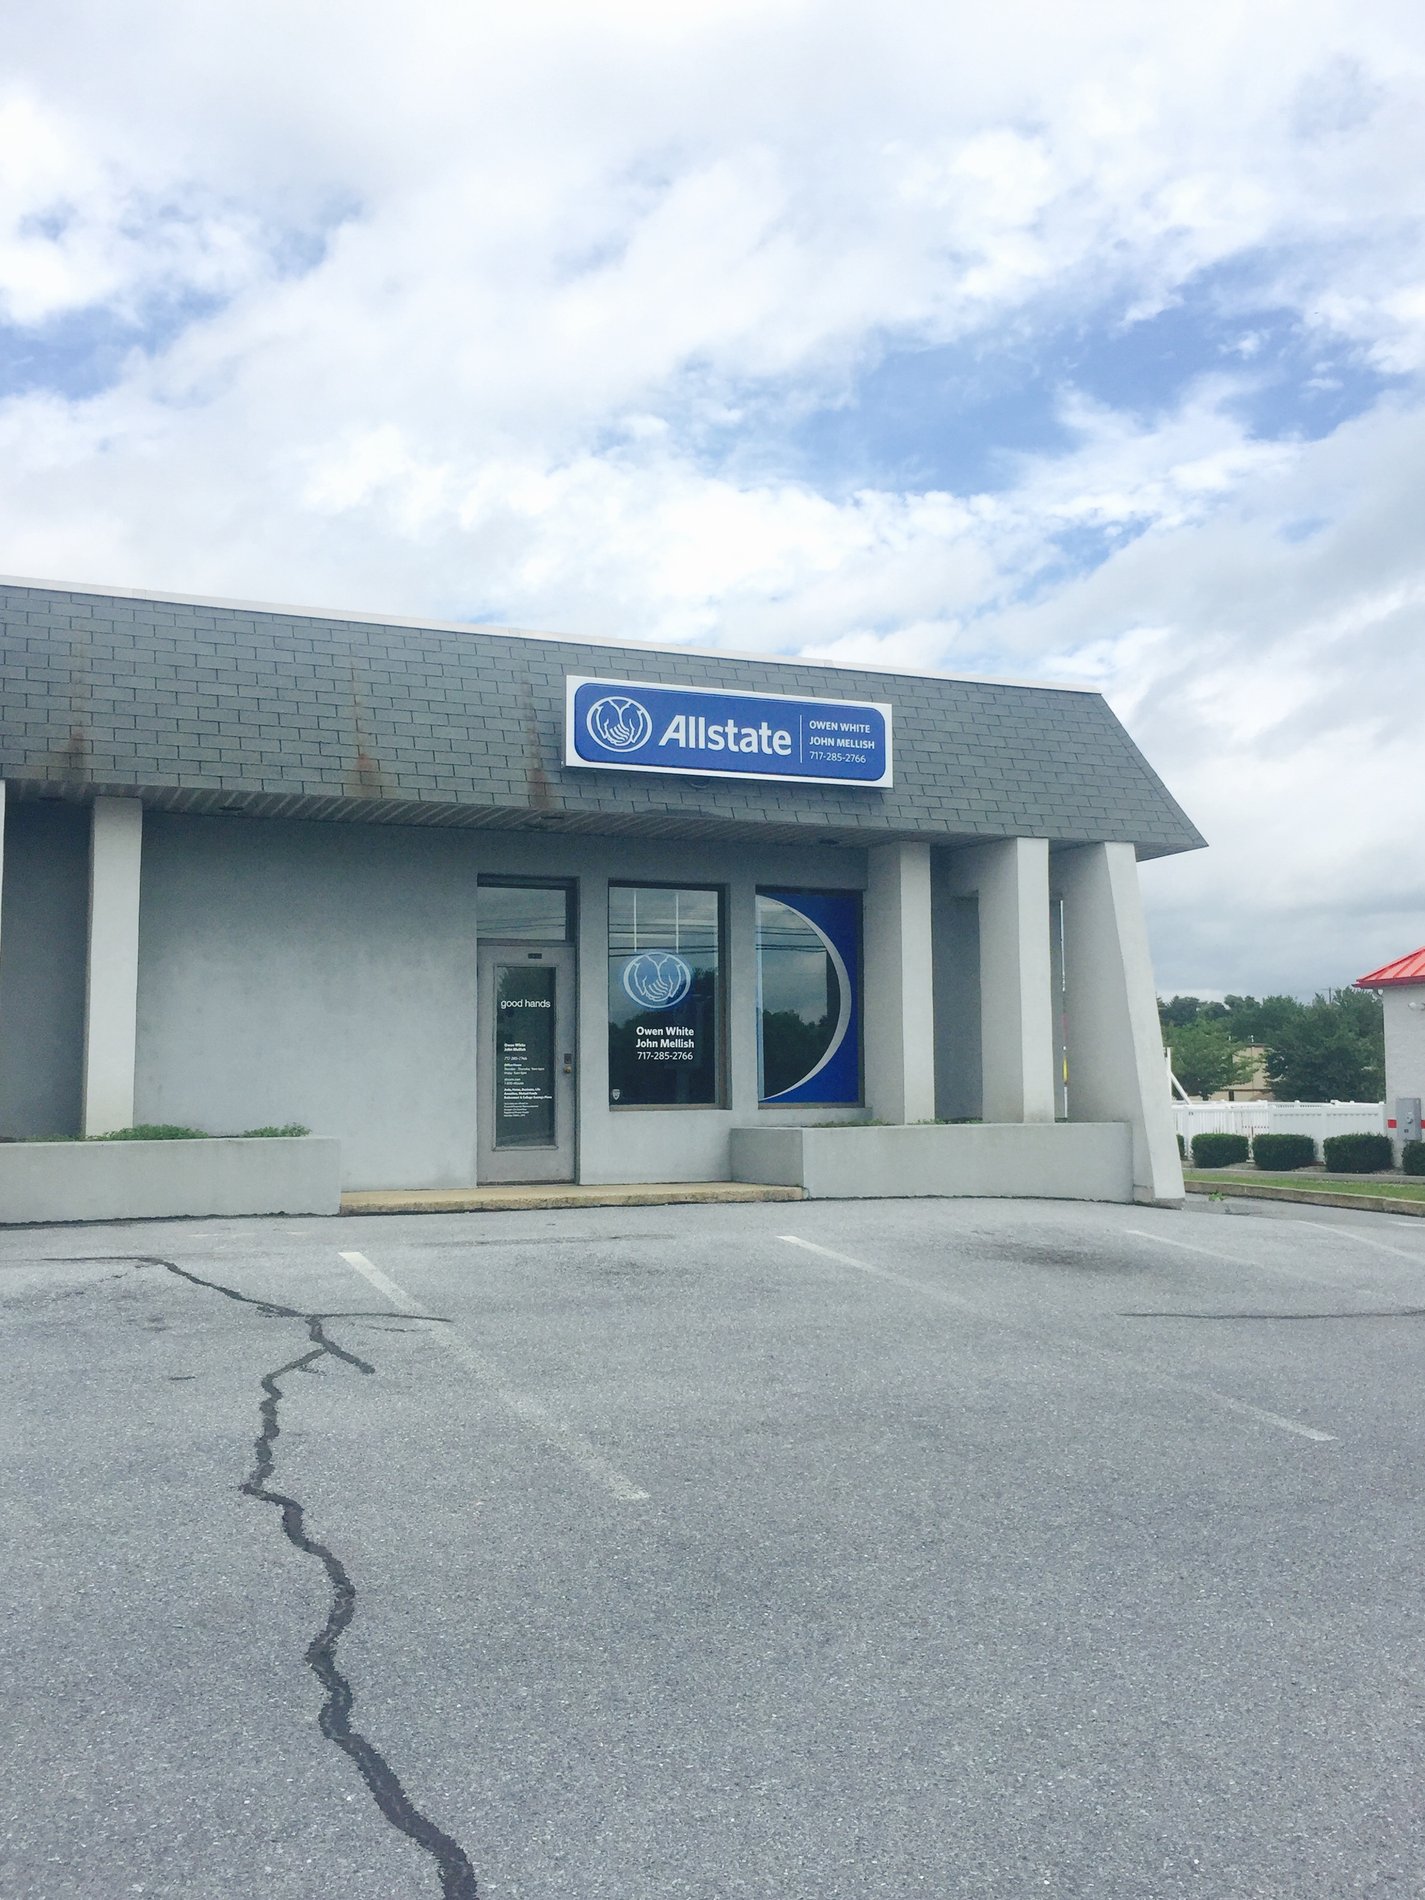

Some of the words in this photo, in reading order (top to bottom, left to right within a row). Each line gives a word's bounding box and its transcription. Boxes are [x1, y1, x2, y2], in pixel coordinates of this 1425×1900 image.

[809, 720, 838, 731] OWEN
[839, 723, 870, 734] WHITE
[658, 714, 792, 756] Allstate
[809, 736, 835, 747] JOHN
[836, 739, 875, 750] MELLISH
[809, 751, 866, 764] 717-285-2766
[500, 999, 523, 1010] good
[524, 999, 551, 1008] hands
[636, 1026, 664, 1036] Owen
[665, 1026, 695, 1036] White
[635, 1038, 658, 1048] John
[660, 1038, 695, 1048] Mellish
[637, 1051, 694, 1060] 717-285-2766
